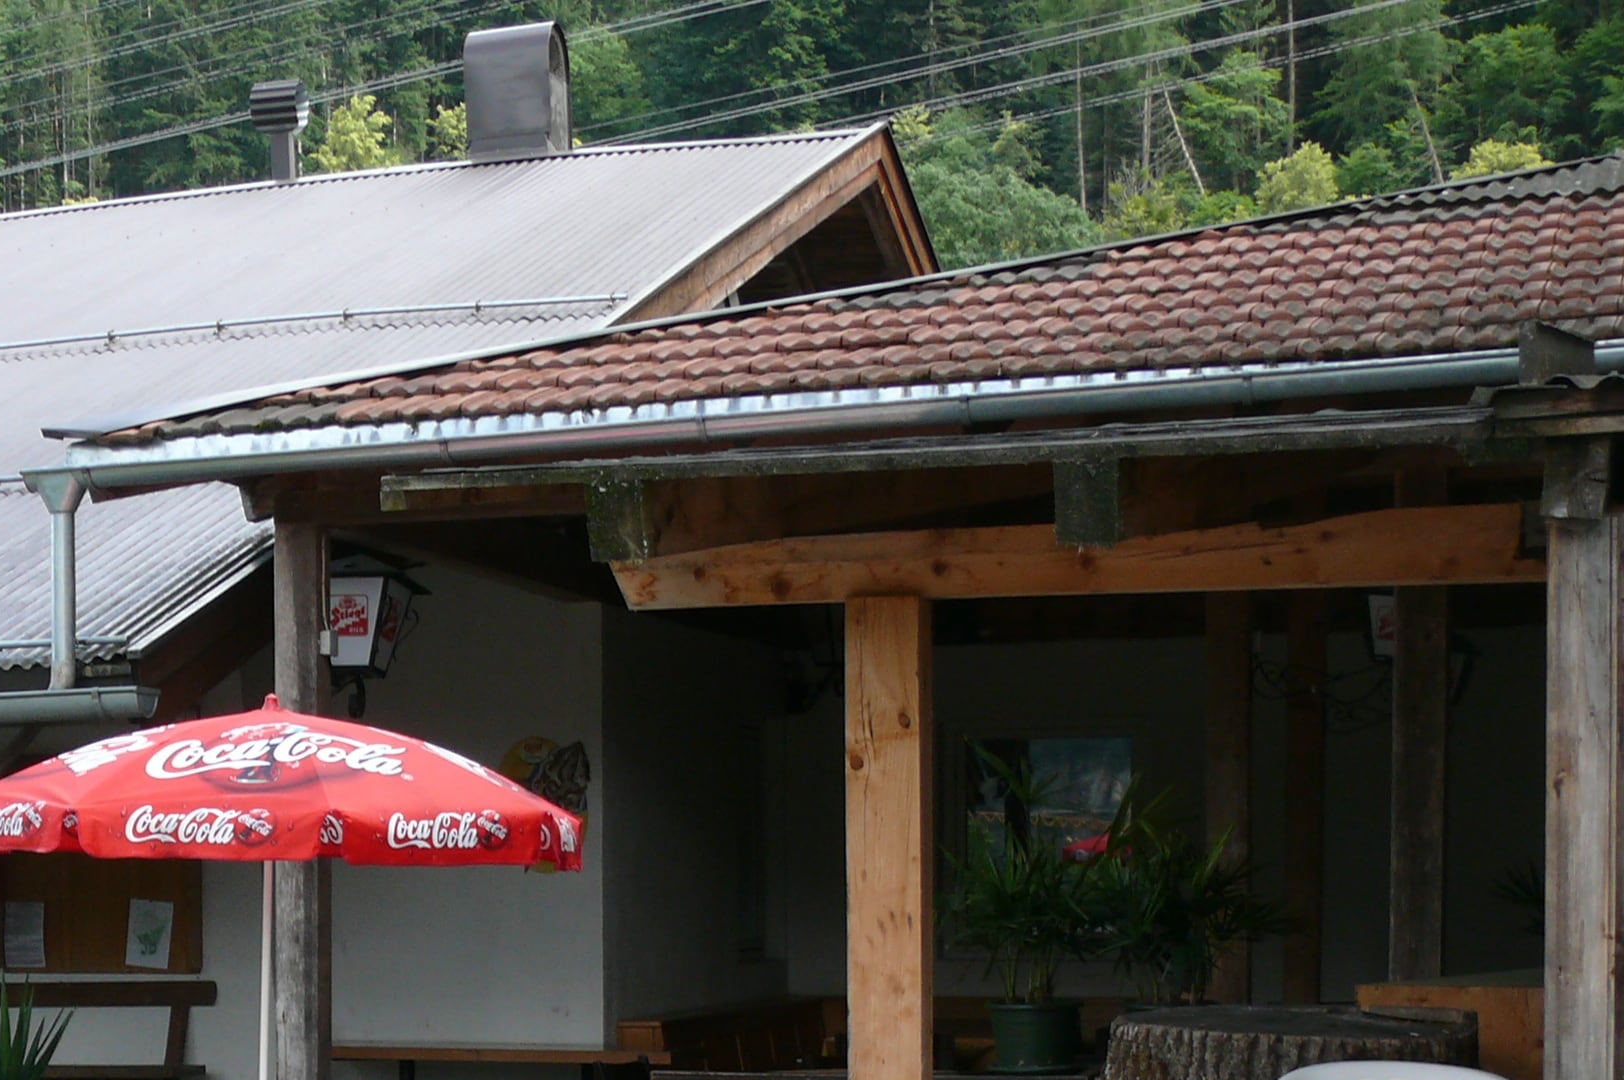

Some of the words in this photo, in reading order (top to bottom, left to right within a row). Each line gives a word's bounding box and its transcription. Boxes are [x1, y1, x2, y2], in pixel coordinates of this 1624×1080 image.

[331, 605, 366, 630] Stiegl
[145, 731, 407, 779] Coca-Cola
[126, 805, 241, 845] Coca-Cola
[388, 811, 478, 849] Coca-Cola
